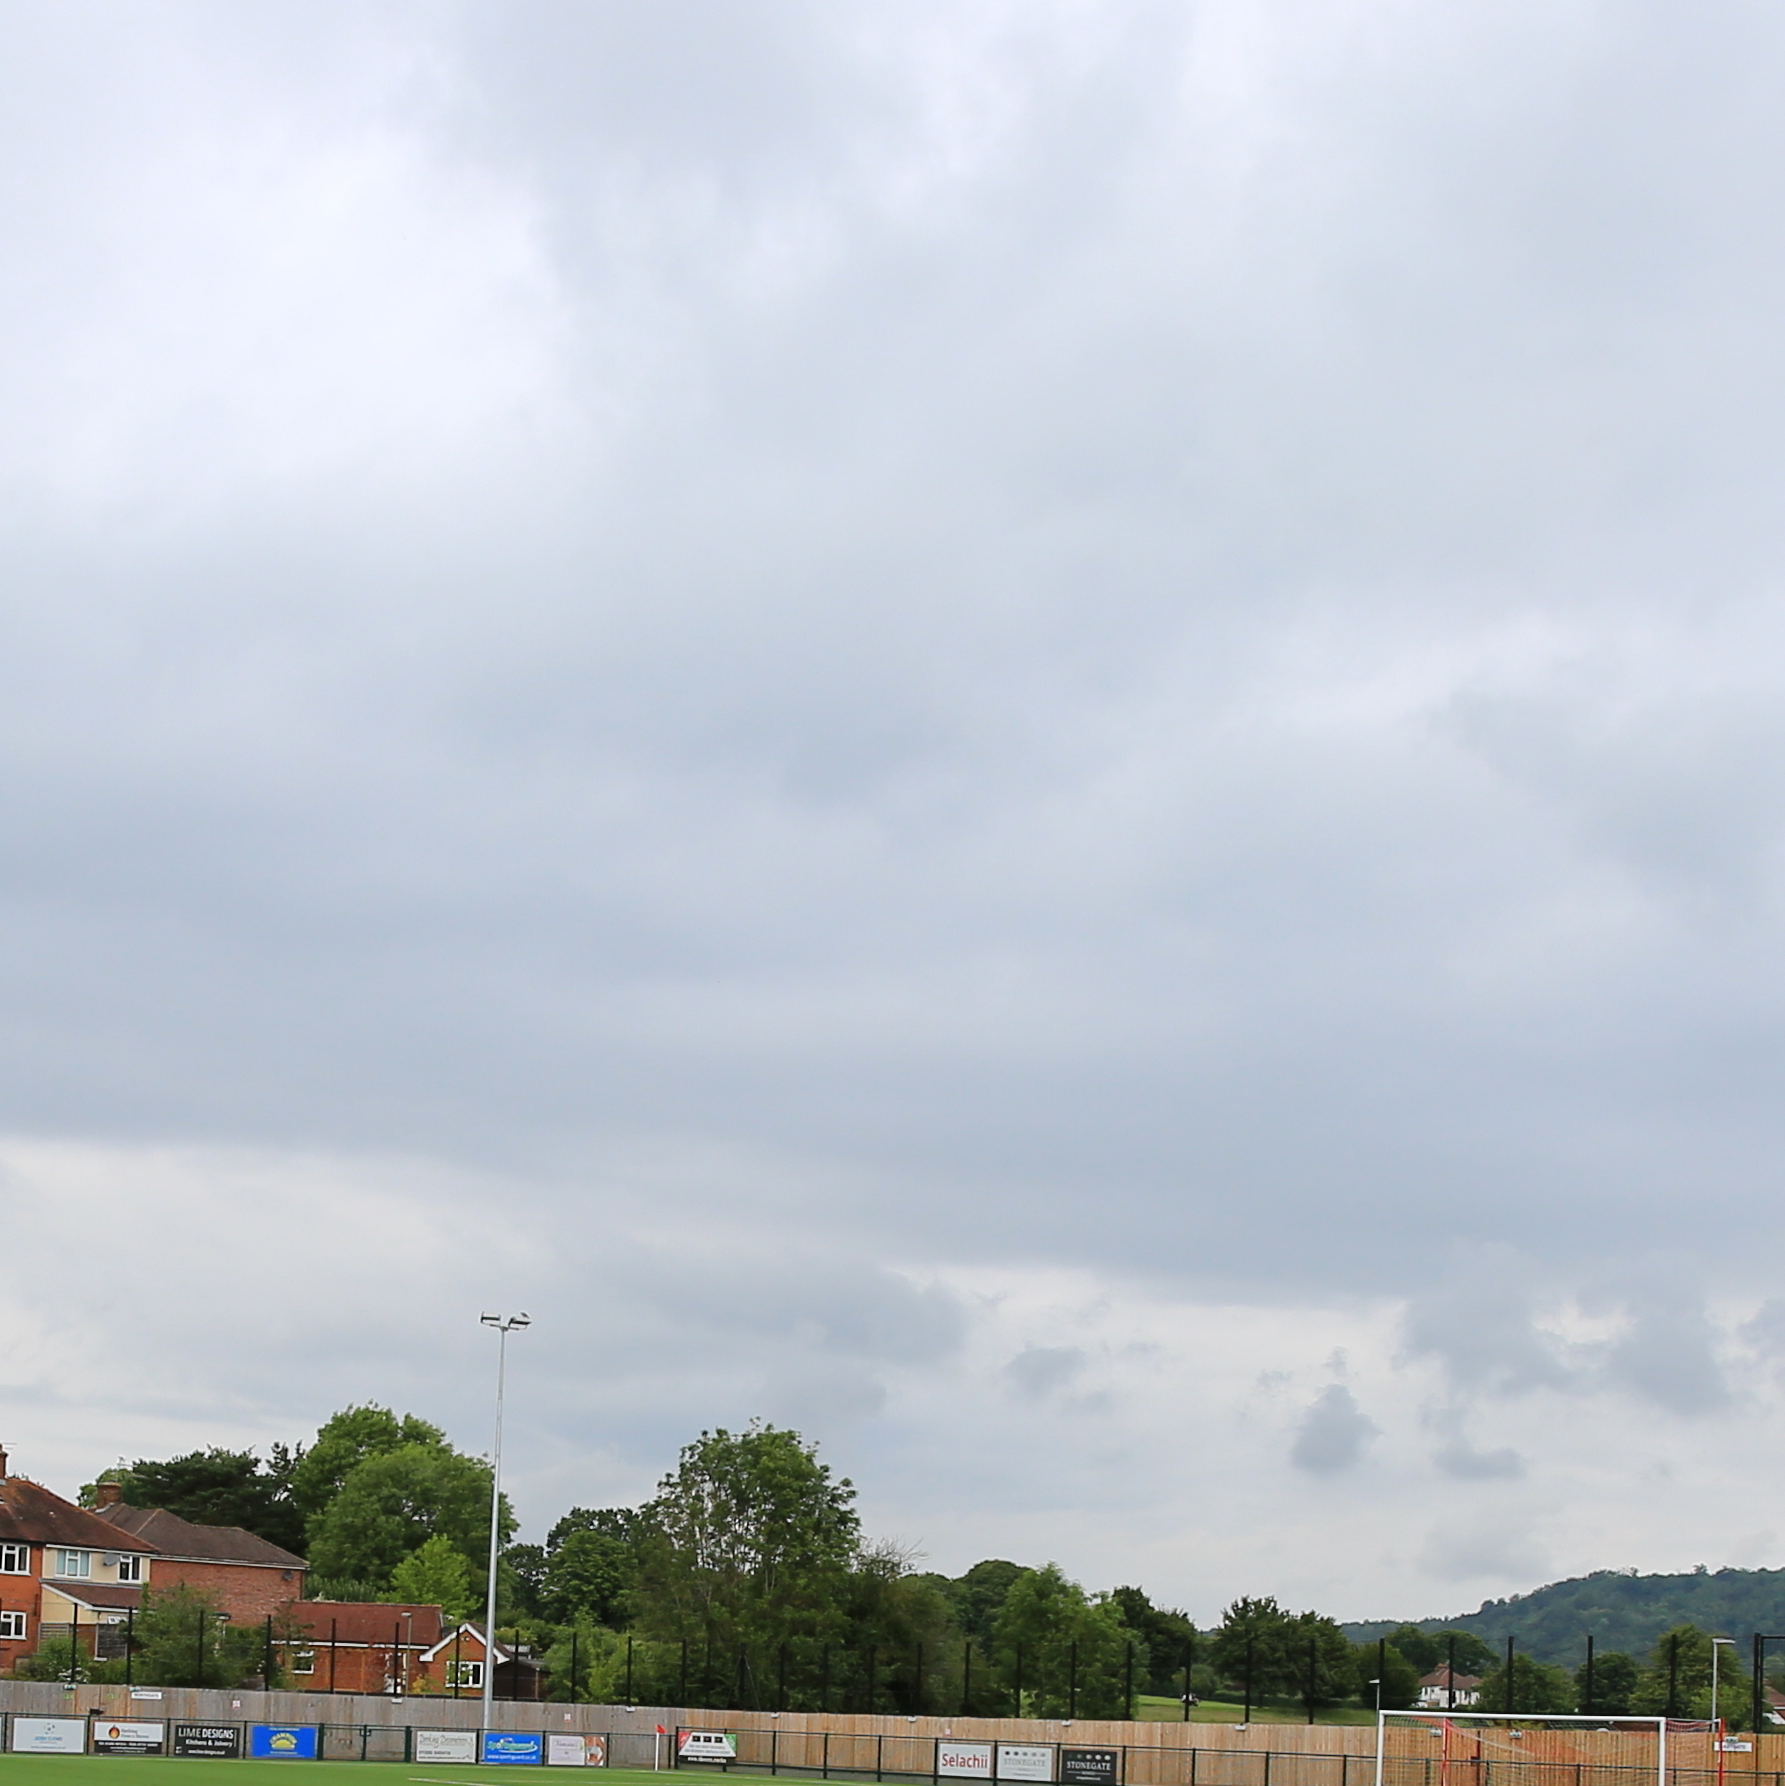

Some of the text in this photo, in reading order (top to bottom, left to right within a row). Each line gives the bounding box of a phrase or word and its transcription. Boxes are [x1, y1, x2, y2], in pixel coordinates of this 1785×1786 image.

[178, 1728, 234, 1739] LIME DESIGNS
[942, 1753, 988, 1768] Selachii
[1066, 1760, 1112, 1771] STONEGATE
